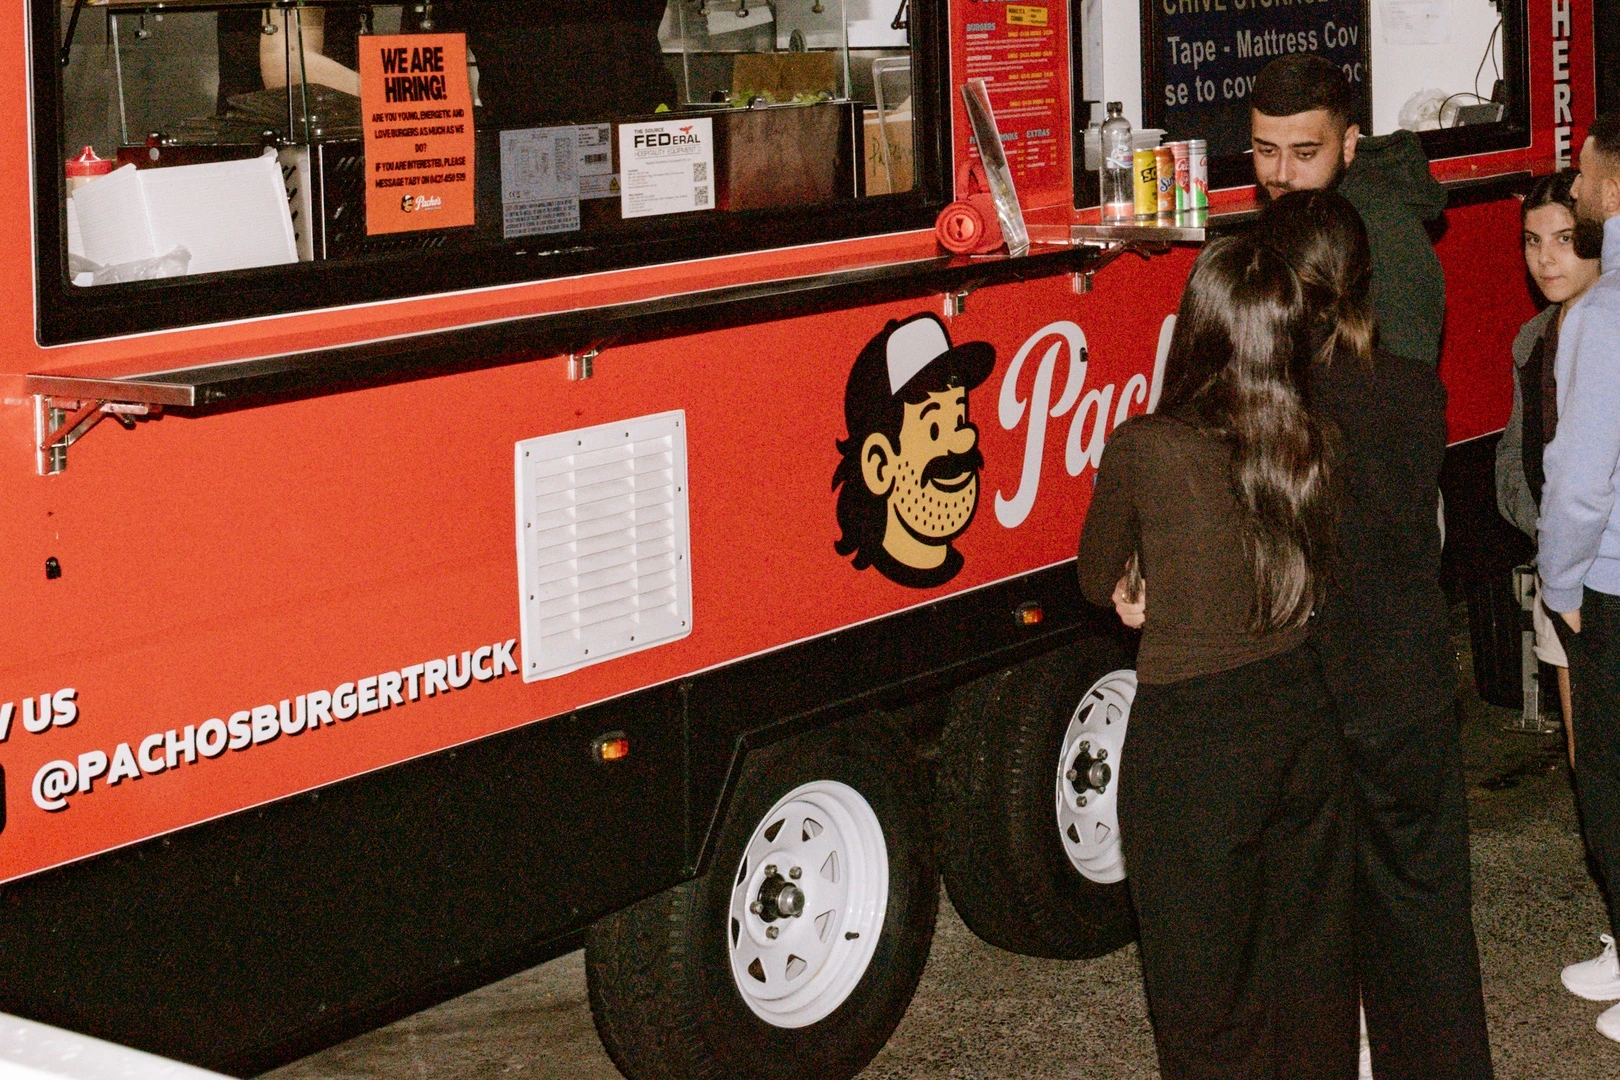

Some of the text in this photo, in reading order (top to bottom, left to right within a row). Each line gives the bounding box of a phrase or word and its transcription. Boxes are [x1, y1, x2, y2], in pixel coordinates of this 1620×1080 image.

[966, 22, 996, 32] BURGERS
[1167, 36, 1216, 70] Tape
[1236, 27, 1318, 59] Mattress
[381, 47, 444, 74] WE ARE
[385, 75, 447, 103] HIRING!
[1194, 77, 1216, 102] to
[372, 109, 464, 122] ARE YOU YOUNG, ENERGETIC AND
[374, 125, 464, 139] LOVE BURGERS AS MUCH AS WE
[1026, 128, 1050, 138] EXTRAS
[415, 143, 427, 152] DO?
[634, 146, 696, 157] HOSPITALITY EQUIPMENT
[375, 162, 382, 172] IF
[382, 162, 394, 171] YOU
[395, 161, 407, 170] ARE
[444, 156, 466, 166] PLEASE
[375, 178, 404, 188] MESSAGE
[421, 175, 430, 184] ON
[415, 195, 441, 211] Pacho's
[22, 688, 78, 731] US
[30, 638, 519, 810] @PACHOSBURGERTRUCK
